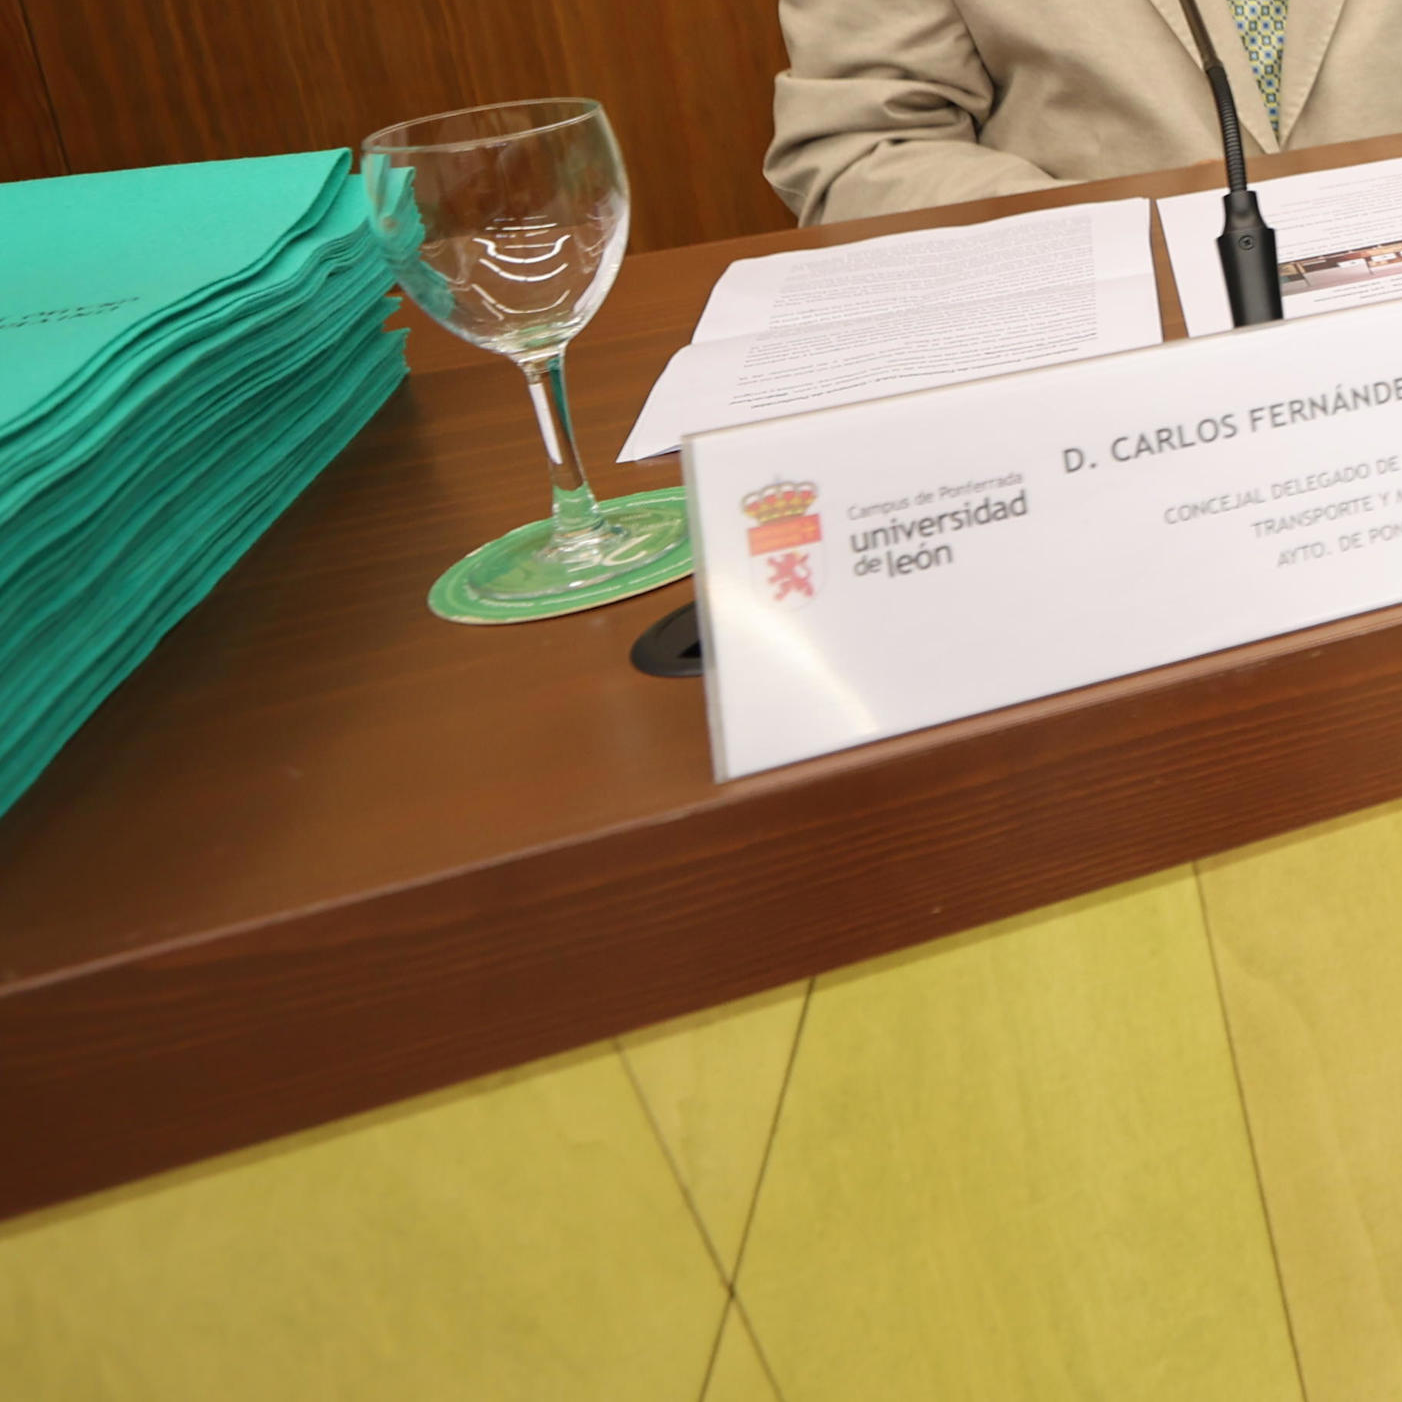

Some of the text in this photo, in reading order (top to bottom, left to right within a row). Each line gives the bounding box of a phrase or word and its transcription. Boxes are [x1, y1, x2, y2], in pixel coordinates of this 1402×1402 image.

[1062, 448, 1098, 473] D.
[1111, 413, 1238, 462] CARLOS
[847, 472, 1023, 520] Campus de Ponferrada
[1164, 488, 1267, 525] CONCEJAL
[1270, 463, 1371, 500] DELEGADO
[1375, 455, 1400, 475] DE
[850, 489, 1028, 553] universidad
[1250, 495, 1374, 538] TRANSPORTE
[1378, 491, 1391, 507] Y
[854, 541, 954, 578] de león
[1277, 541, 1333, 568] AYTO.
[1338, 531, 1363, 552] DE
